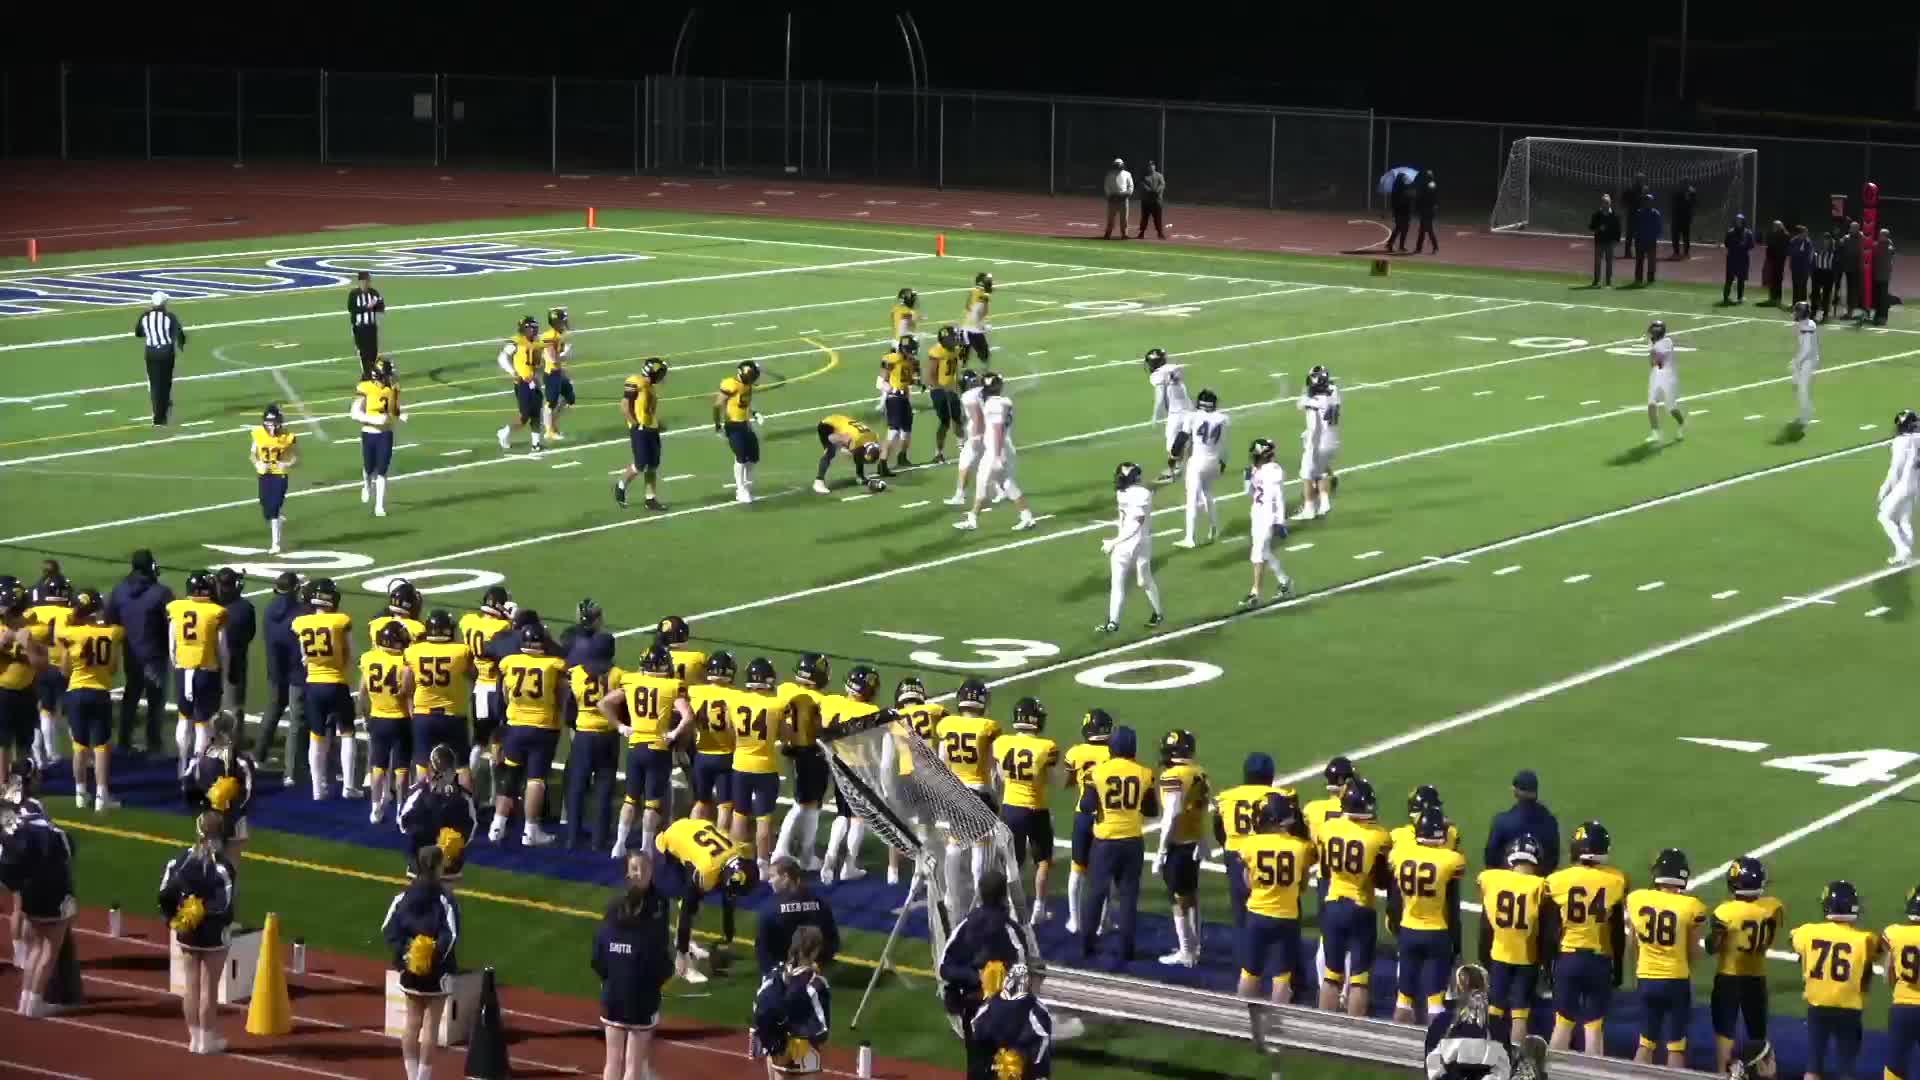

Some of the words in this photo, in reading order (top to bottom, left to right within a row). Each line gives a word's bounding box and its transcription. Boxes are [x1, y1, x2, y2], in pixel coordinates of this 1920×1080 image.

[182, 610, 198, 641] 2
[301, 627, 334, 657] 23
[369, 663, 399, 695] 24
[418, 656, 451, 687] 55
[909, 638, 1225, 690] 30
[511, 667, 543, 699] 73
[634, 685, 659, 719] 81
[736, 705, 768, 740] 34
[945, 732, 978, 764] 25
[1002, 748, 1034, 781] 42
[1105, 775, 1140, 810] 20
[1256, 850, 1295, 887] 58
[1327, 836, 1364, 874] 88
[1399, 859, 1437, 897] 82
[1496, 889, 1529, 930] 91
[1567, 886, 1607, 924] 64
[1638, 906, 1678, 946] 38
[1738, 919, 1772, 953] 30
[1809, 939, 1852, 982] 76
